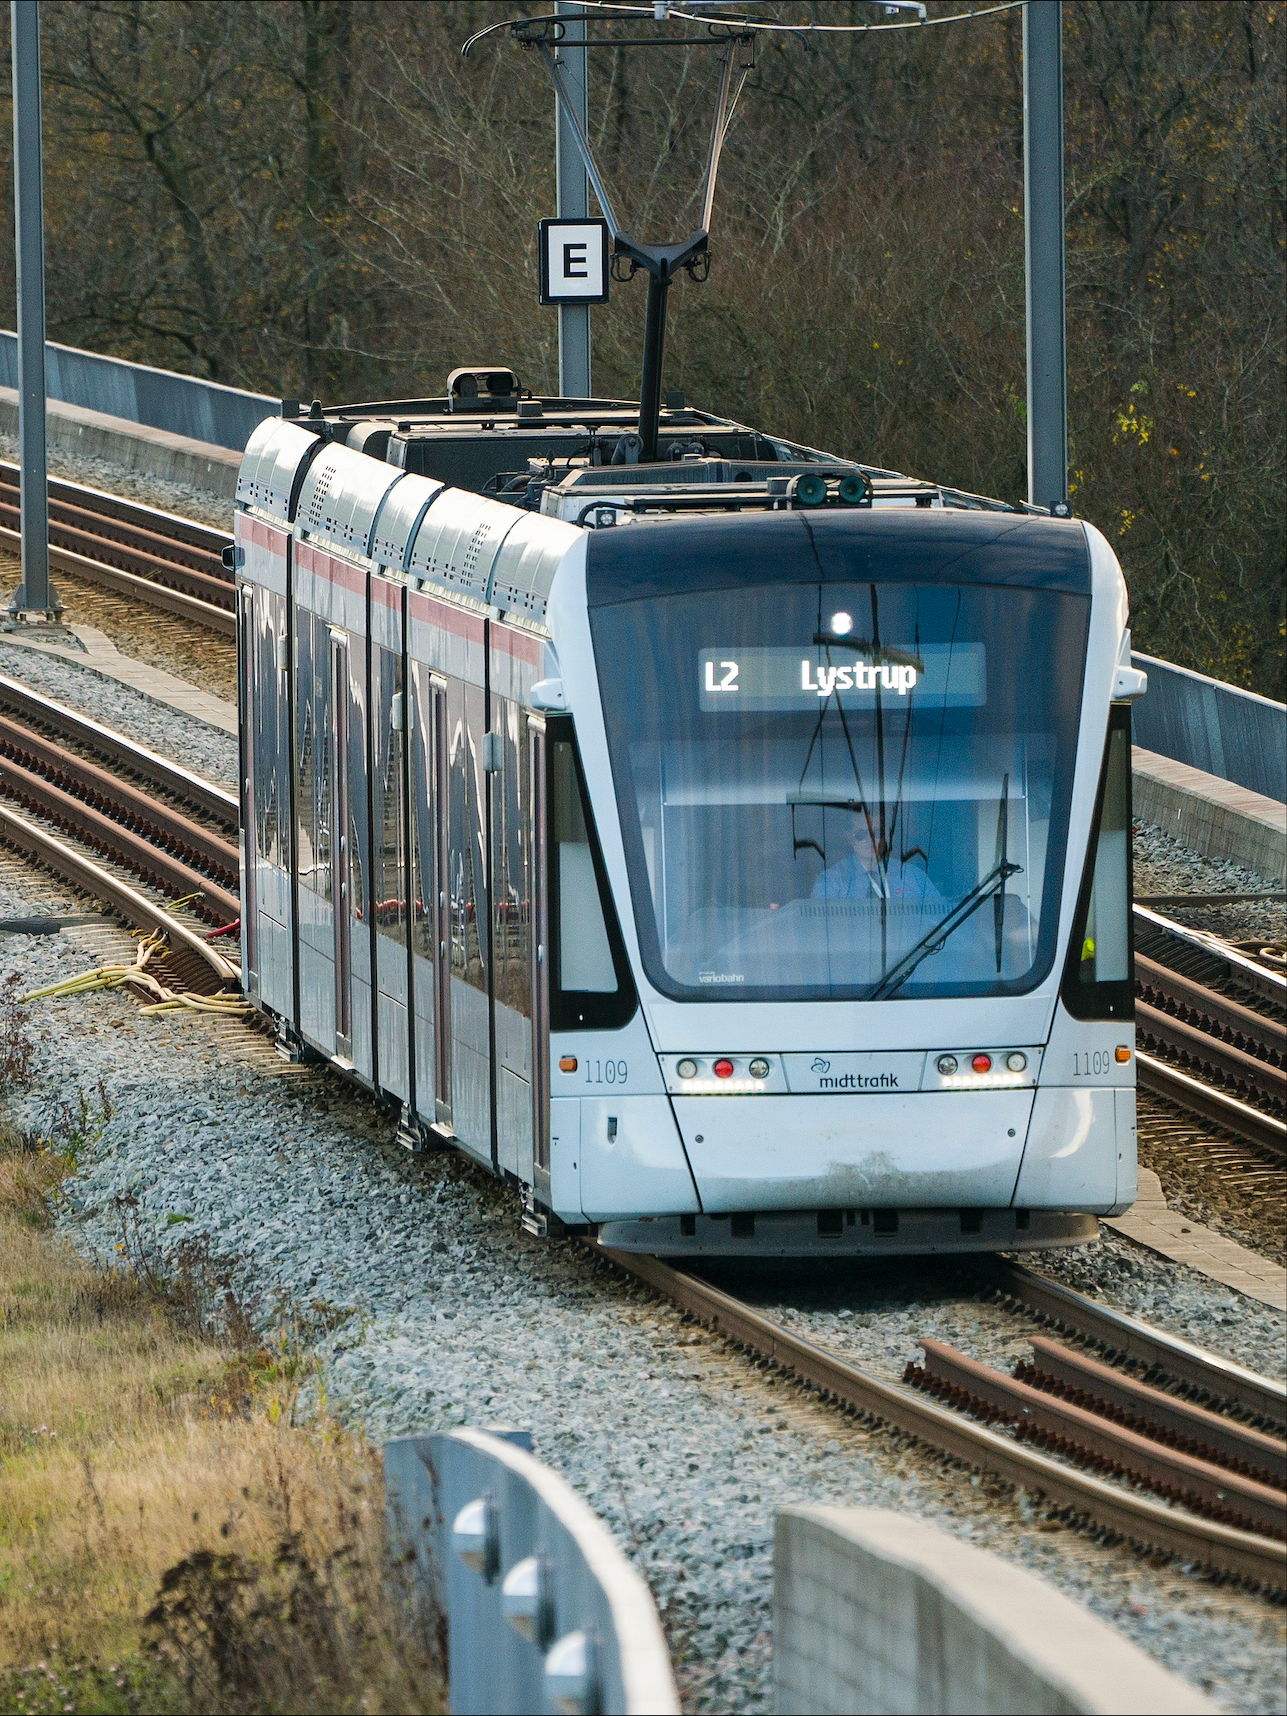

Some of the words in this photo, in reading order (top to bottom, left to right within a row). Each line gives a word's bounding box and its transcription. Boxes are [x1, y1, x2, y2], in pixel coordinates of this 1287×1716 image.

[563, 243, 588, 278] E
[705, 661, 739, 692] L2
[801, 660, 918, 697] Lystrup
[698, 973, 745, 983] variobahn
[585, 1060, 628, 1084] 1109
[1073, 1050, 1110, 1076] 1109
[819, 1073, 899, 1088] midttrafik
